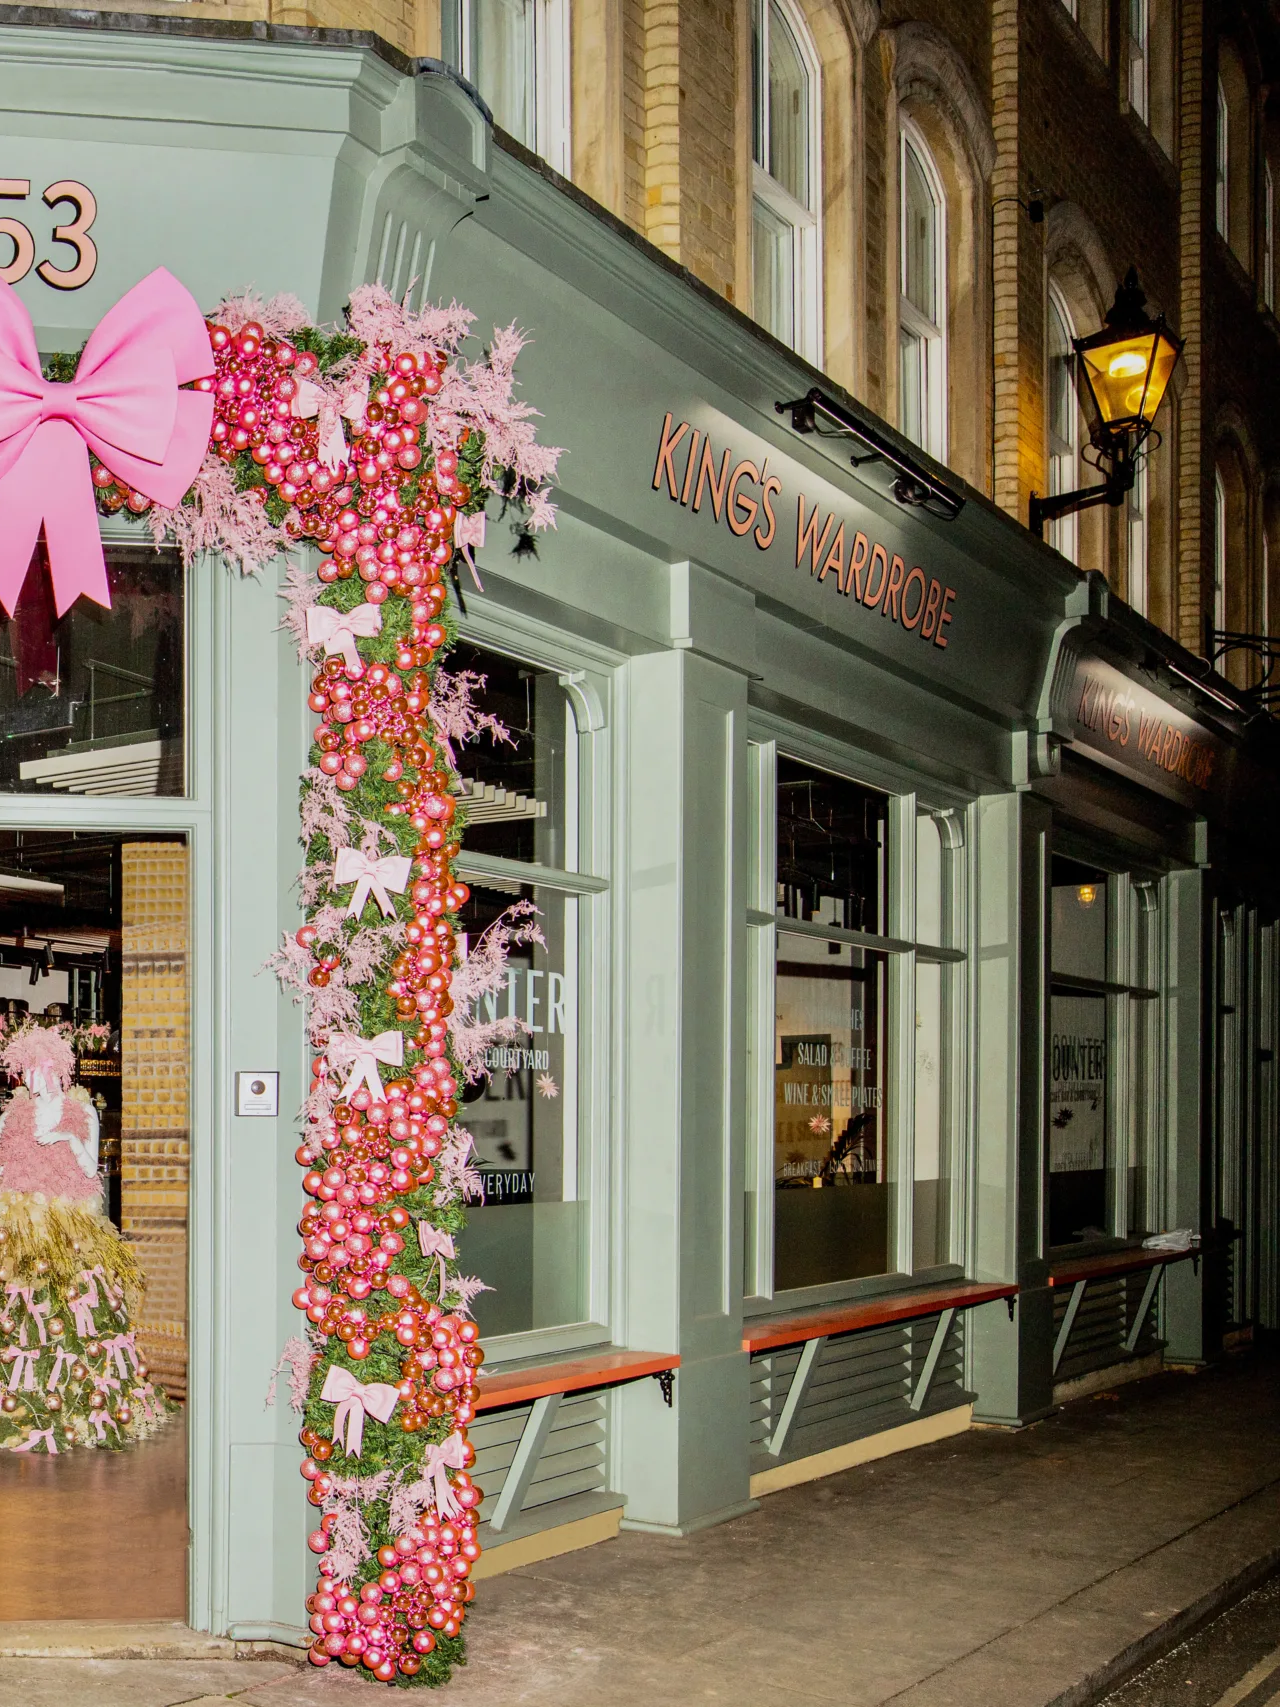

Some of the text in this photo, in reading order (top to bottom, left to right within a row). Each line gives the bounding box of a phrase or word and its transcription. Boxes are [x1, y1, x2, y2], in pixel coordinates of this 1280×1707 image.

[651, 410, 957, 650] KING'S WARDROBE
[1076, 674, 1215, 791] KING'S WARDROBE
[485, 1047, 550, 1071] COURTYARD
[797, 1042, 828, 1067] SALAD
[784, 1082, 809, 1106] WINE
[811, 1084, 819, 1107] &
[852, 1085, 883, 1109] PLATES
